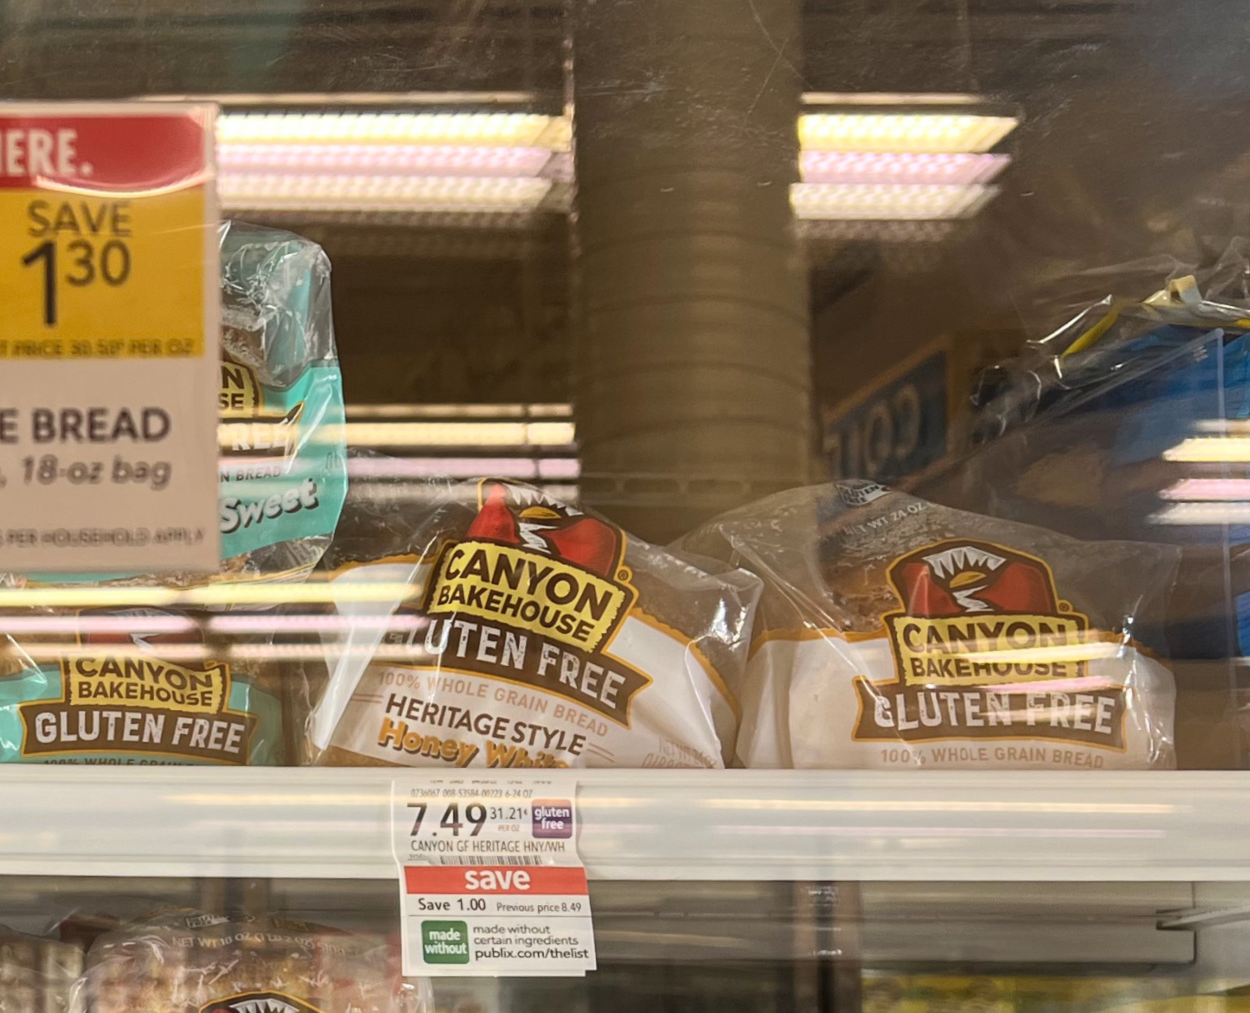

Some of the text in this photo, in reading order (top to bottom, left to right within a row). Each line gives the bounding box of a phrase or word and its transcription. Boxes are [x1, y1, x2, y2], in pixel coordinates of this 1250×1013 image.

[27, 200, 132, 237] SAVE
[31, 406, 171, 444] BREAD
[21, 453, 104, 486] 18-oz
[111, 453, 172, 491] bag
[445, 548, 614, 622] CANYON
[437, 584, 595, 643] BAKEHOUSE
[76, 656, 213, 691] CANYON
[78, 681, 213, 707] BAKEHOUSE
[385, 693, 587, 756] HERITAGE STYLE
[874, 690, 1115, 735] GLUTEN FREE
[35, 710, 246, 754] GLUTEN FREE
[407, 802, 487, 837] 7.49
[534, 806, 570, 821] gluten
[541, 818, 564, 830] free
[411, 840, 453, 852] CANYON
[457, 840, 470, 852] GF
[472, 840, 520, 852] HERITAGE
[464, 870, 531, 891] save
[418, 897, 582, 914] Save 1.00 Previous price 8.49
